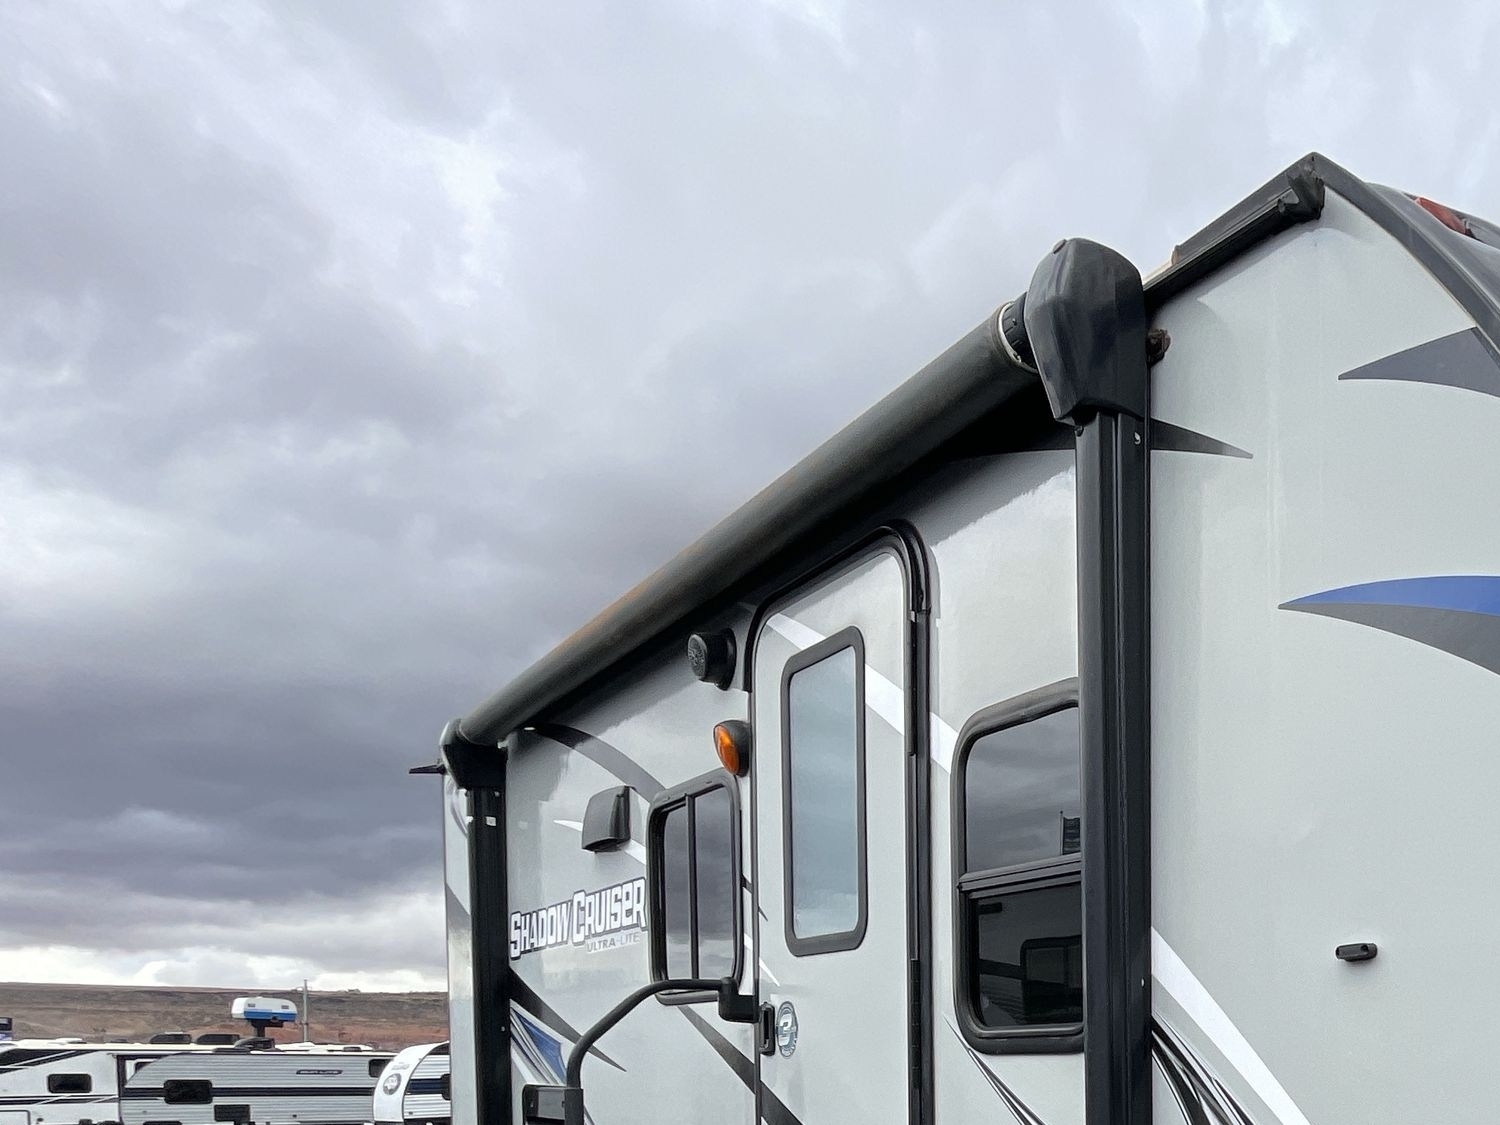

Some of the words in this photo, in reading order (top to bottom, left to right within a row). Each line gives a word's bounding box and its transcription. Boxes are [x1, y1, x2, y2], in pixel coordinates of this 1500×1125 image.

[510, 900, 572, 960] SHADOW
[572, 877, 648, 946] CRUISER
[587, 934, 640, 953] ULTRA-LITE
